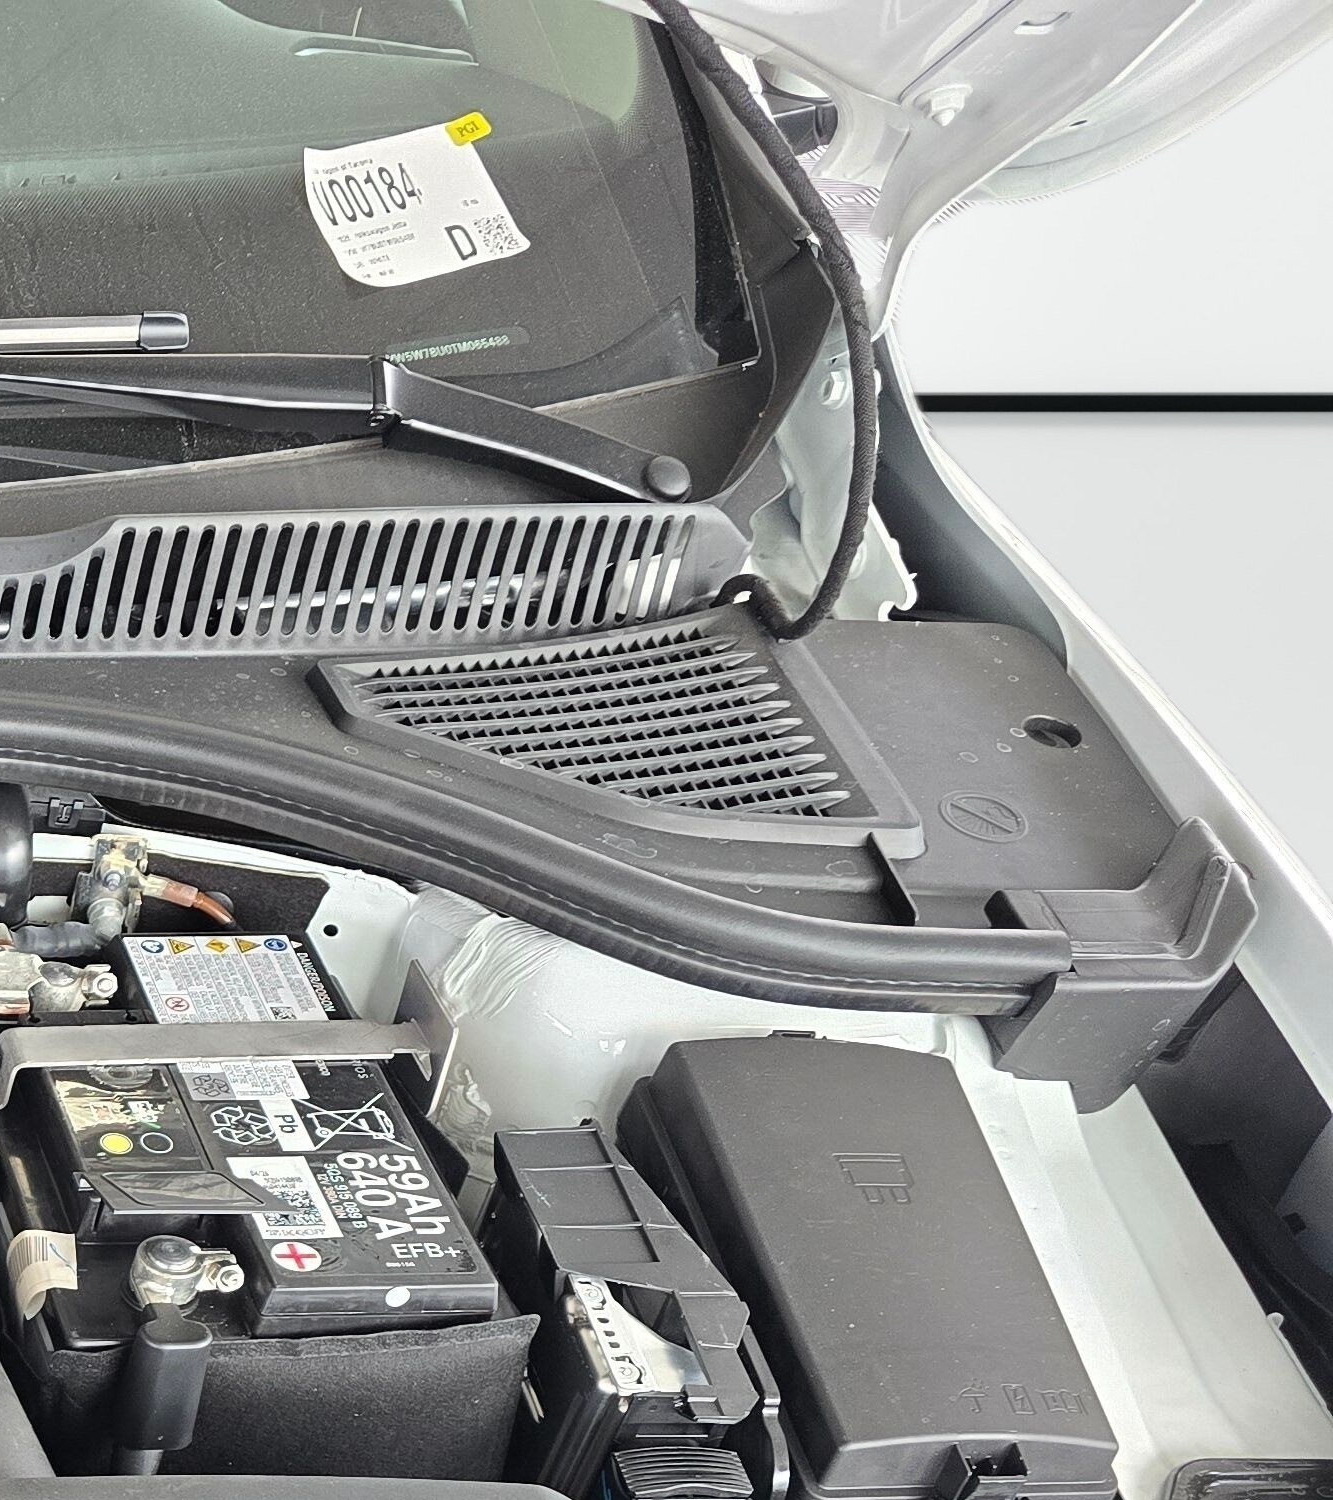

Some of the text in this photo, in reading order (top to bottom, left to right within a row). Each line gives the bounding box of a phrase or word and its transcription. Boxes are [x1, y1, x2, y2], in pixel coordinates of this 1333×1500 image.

[444, 224, 477, 261] D
[296, 951, 337, 1012] DANGER/POISON
[274, 1114, 299, 1134] Pb
[333, 1205, 348, 1219] DIN
[335, 1185, 368, 1229] 915 089 B
[336, 1152, 396, 1206] 640
[367, 1215, 413, 1240] A
[378, 1154, 451, 1235] 59Ah
[391, 1243, 461, 1258] EFB+
